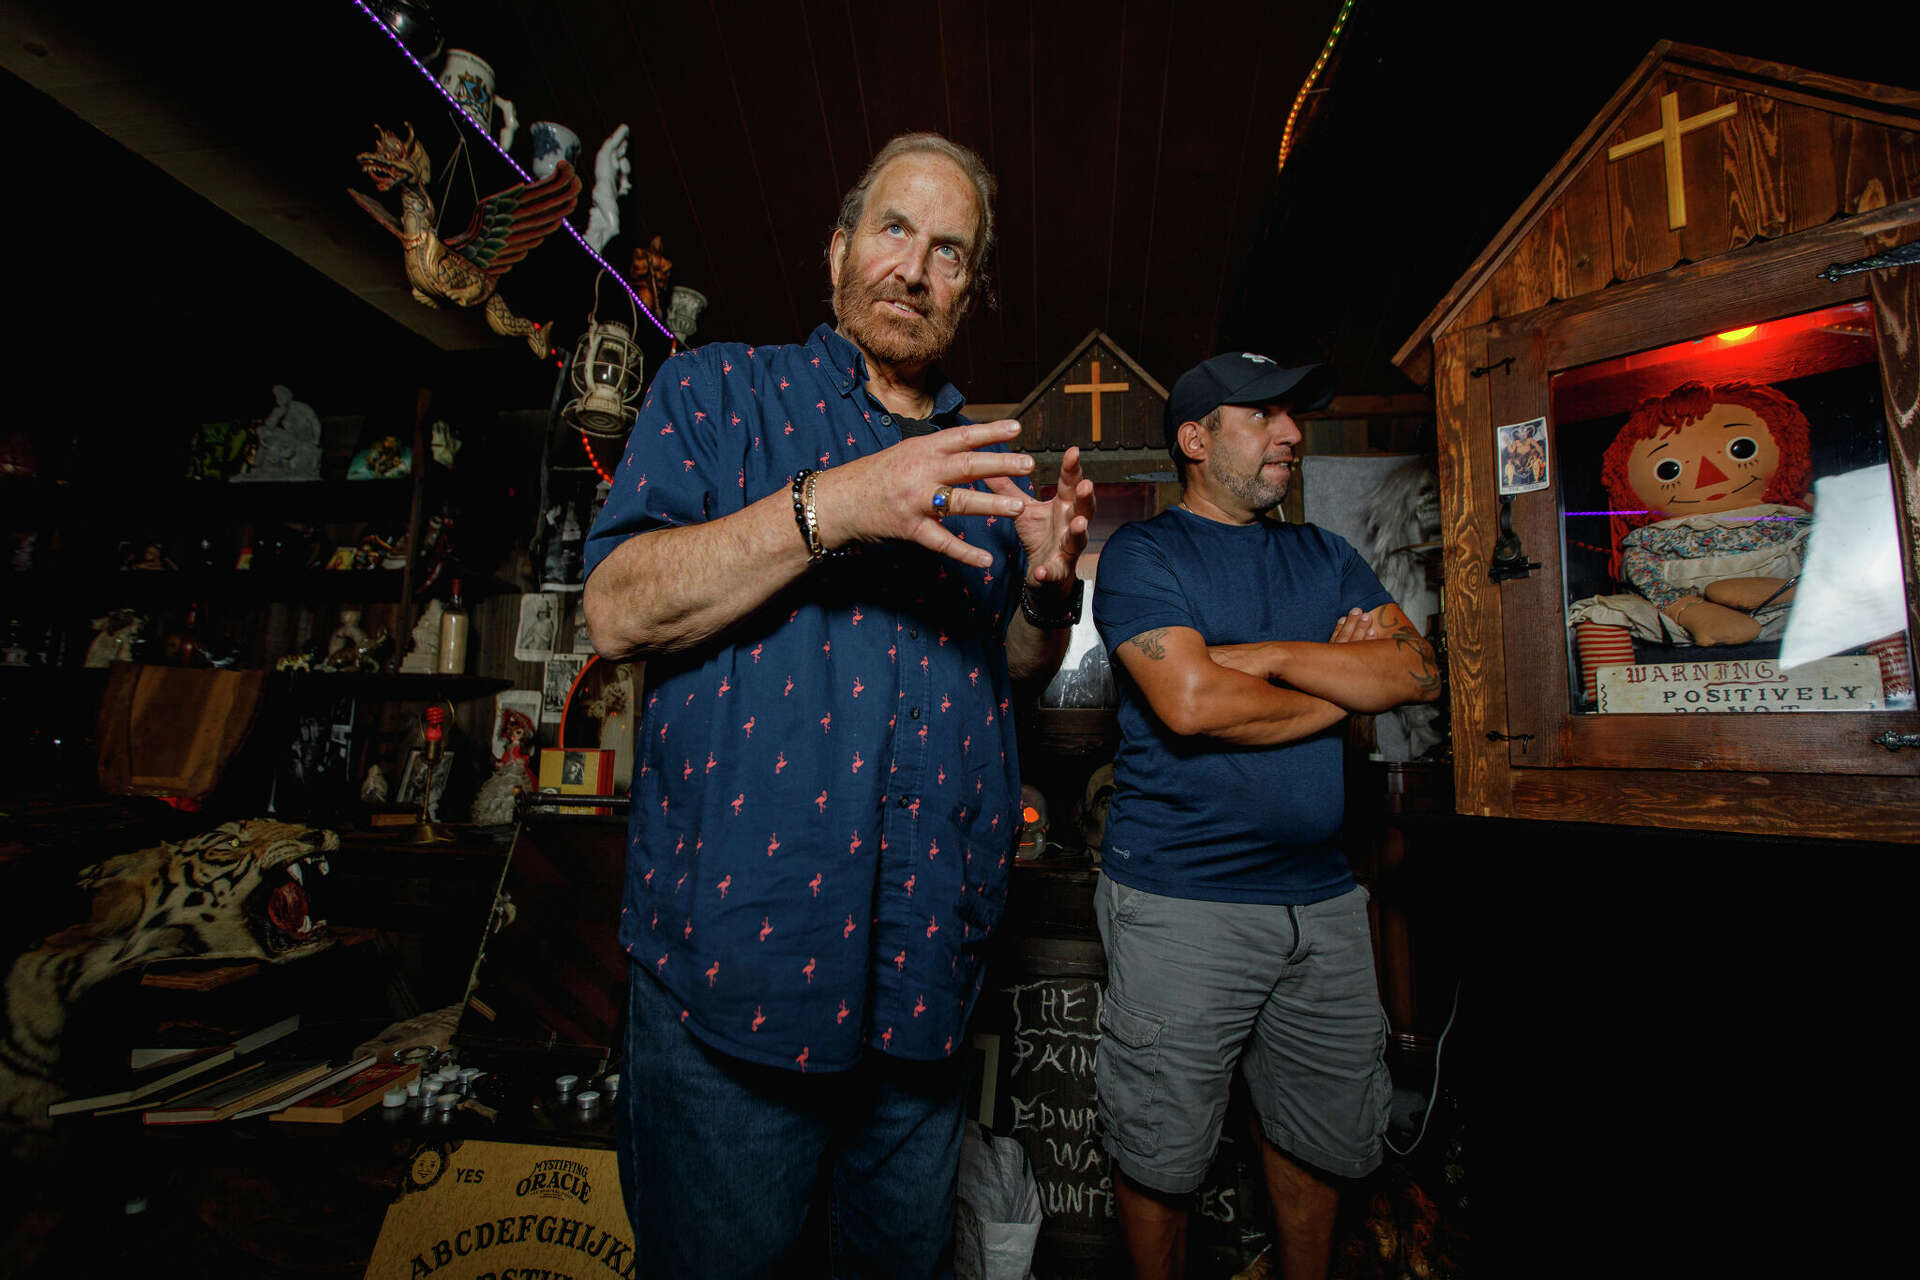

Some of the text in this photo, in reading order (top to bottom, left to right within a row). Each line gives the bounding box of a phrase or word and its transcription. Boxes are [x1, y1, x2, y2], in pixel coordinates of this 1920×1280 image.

[1626, 661, 1774, 684] WARNING
[1663, 685, 1863, 704] POSITIVELY
[1010, 1036, 1098, 1080] PAIN
[1009, 1090, 1099, 1138] EDWA
[535, 1159, 588, 1178] MYSTIFYING
[1046, 1138, 1101, 1173] WA
[456, 1168, 484, 1184] YES
[516, 1171, 591, 1204] ORACLE
